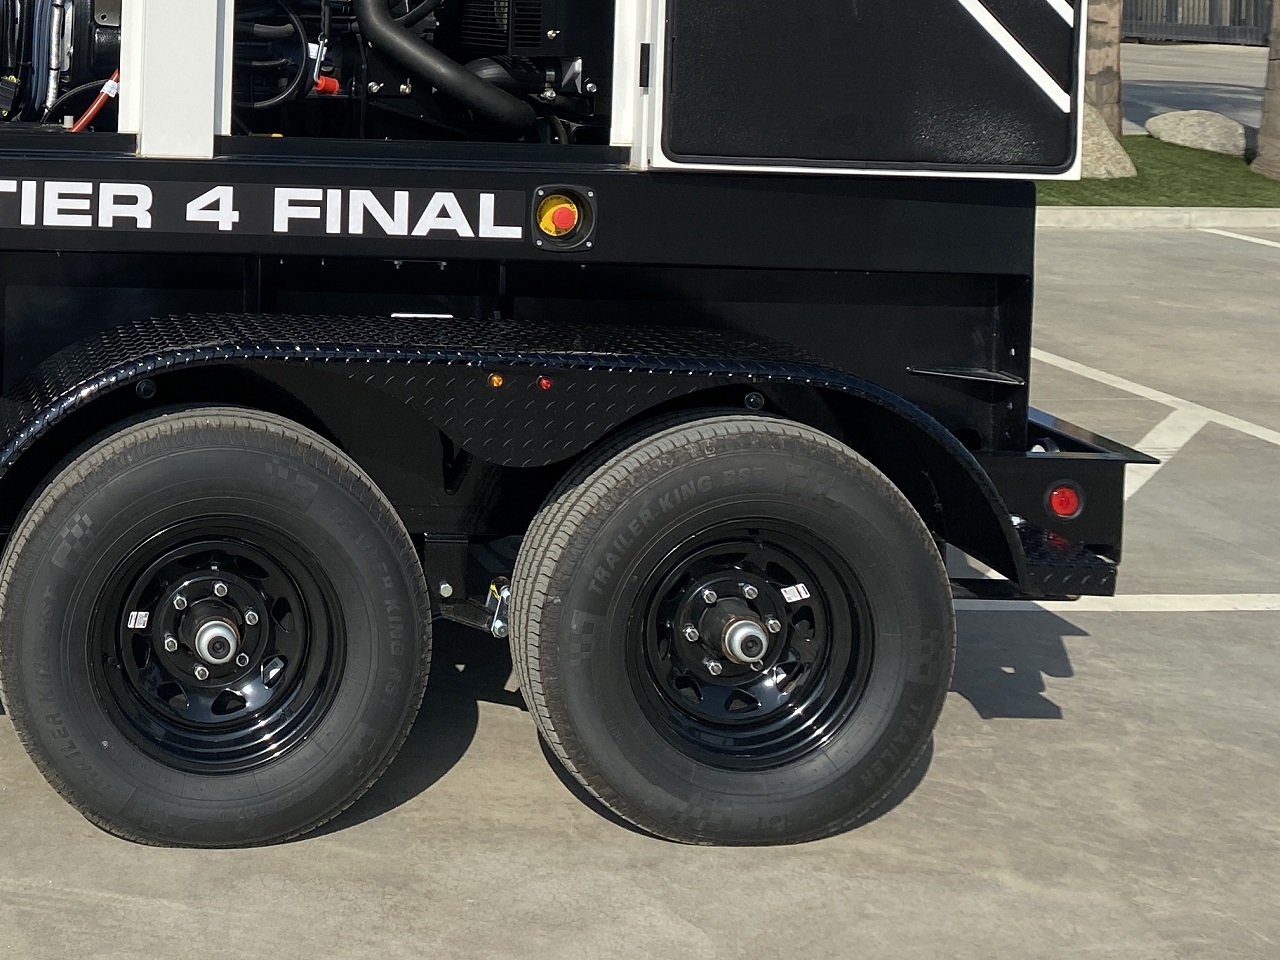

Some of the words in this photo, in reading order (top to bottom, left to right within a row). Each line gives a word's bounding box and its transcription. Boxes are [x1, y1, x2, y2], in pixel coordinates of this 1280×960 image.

[185, 185, 239, 231] 4
[273, 187, 523, 239] FINAL
[587, 508, 656, 596] TRAILER
[658, 475, 713, 514] KING
